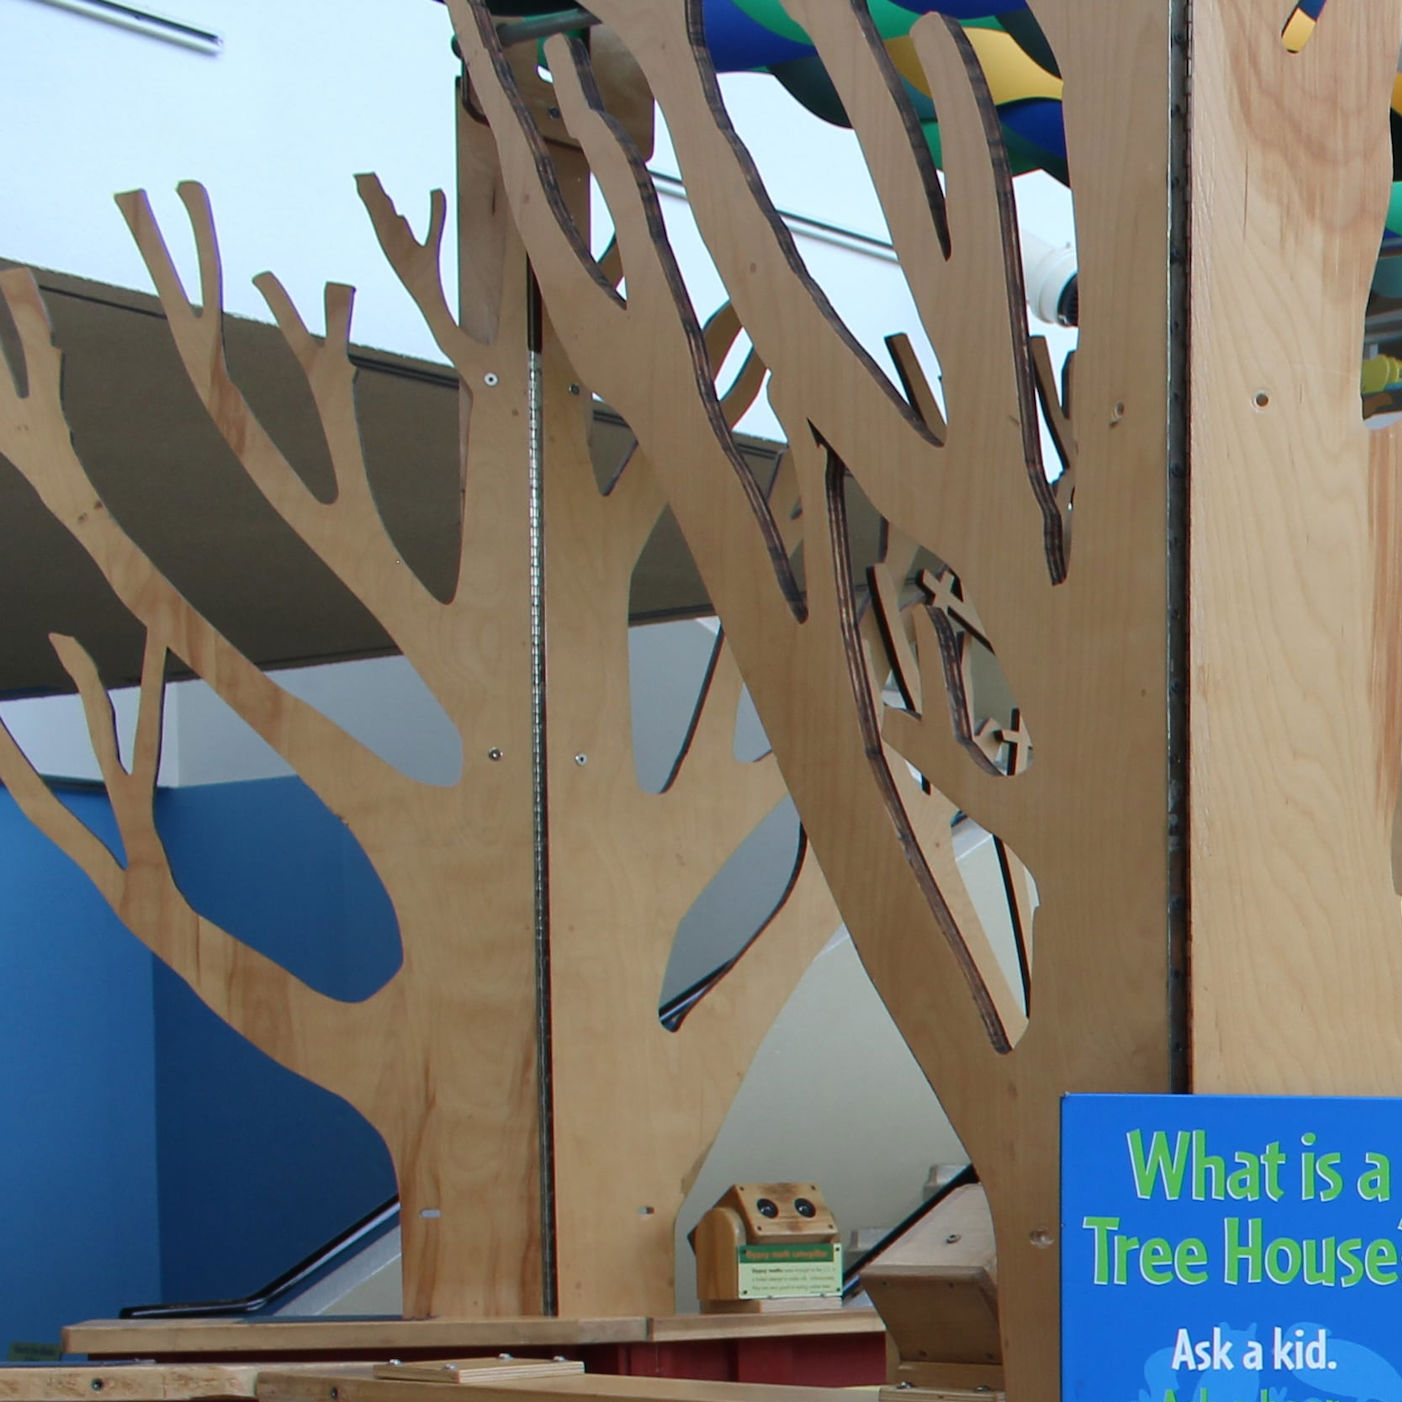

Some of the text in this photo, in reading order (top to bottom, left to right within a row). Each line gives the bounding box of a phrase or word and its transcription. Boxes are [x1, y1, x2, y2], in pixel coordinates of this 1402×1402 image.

[1126, 1129, 1390, 1202] What is a
[1082, 1216, 1208, 1286] Tree
[1172, 1327, 1337, 1370] Ask a kid.
